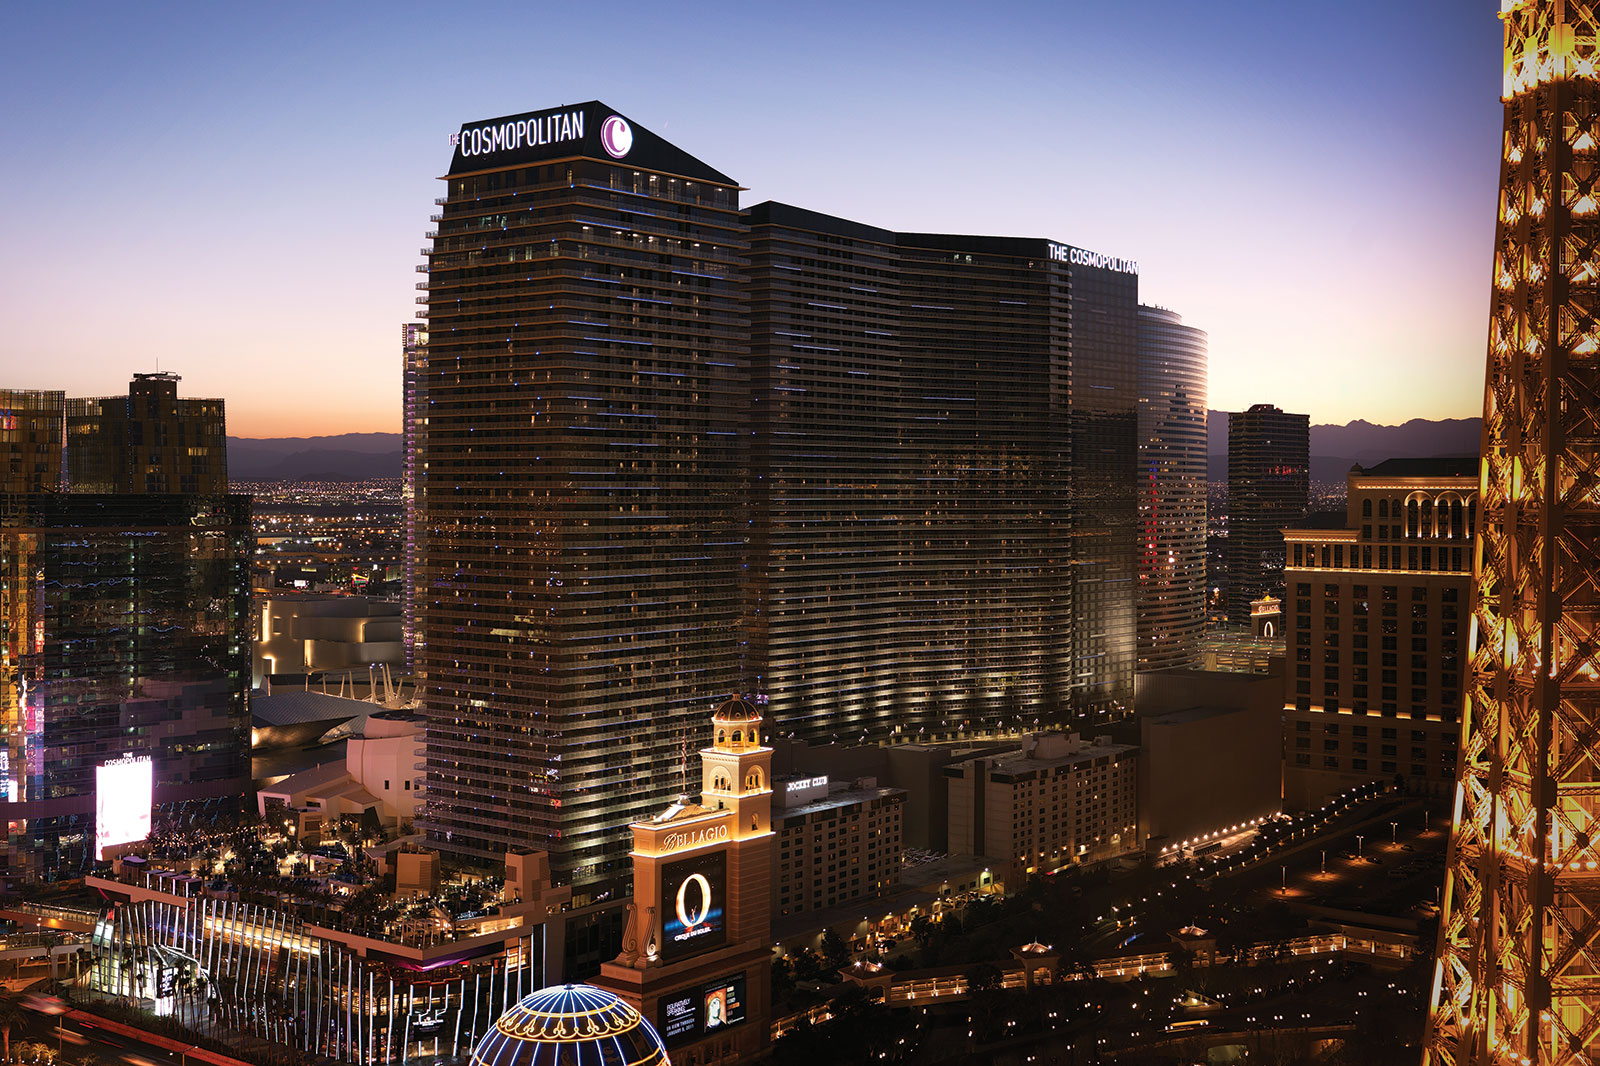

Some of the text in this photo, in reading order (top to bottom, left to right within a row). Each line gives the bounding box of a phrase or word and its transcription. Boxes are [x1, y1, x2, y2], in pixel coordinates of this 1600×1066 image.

[448, 110, 584, 157] THE COSMOPOLITAN
[1048, 243, 1138, 275] THE COSMOPOLITAN
[104, 755, 152, 767] COSMOPOLITAN
[660, 825, 728, 851] BELLAGIO
[675, 873, 711, 928] O
